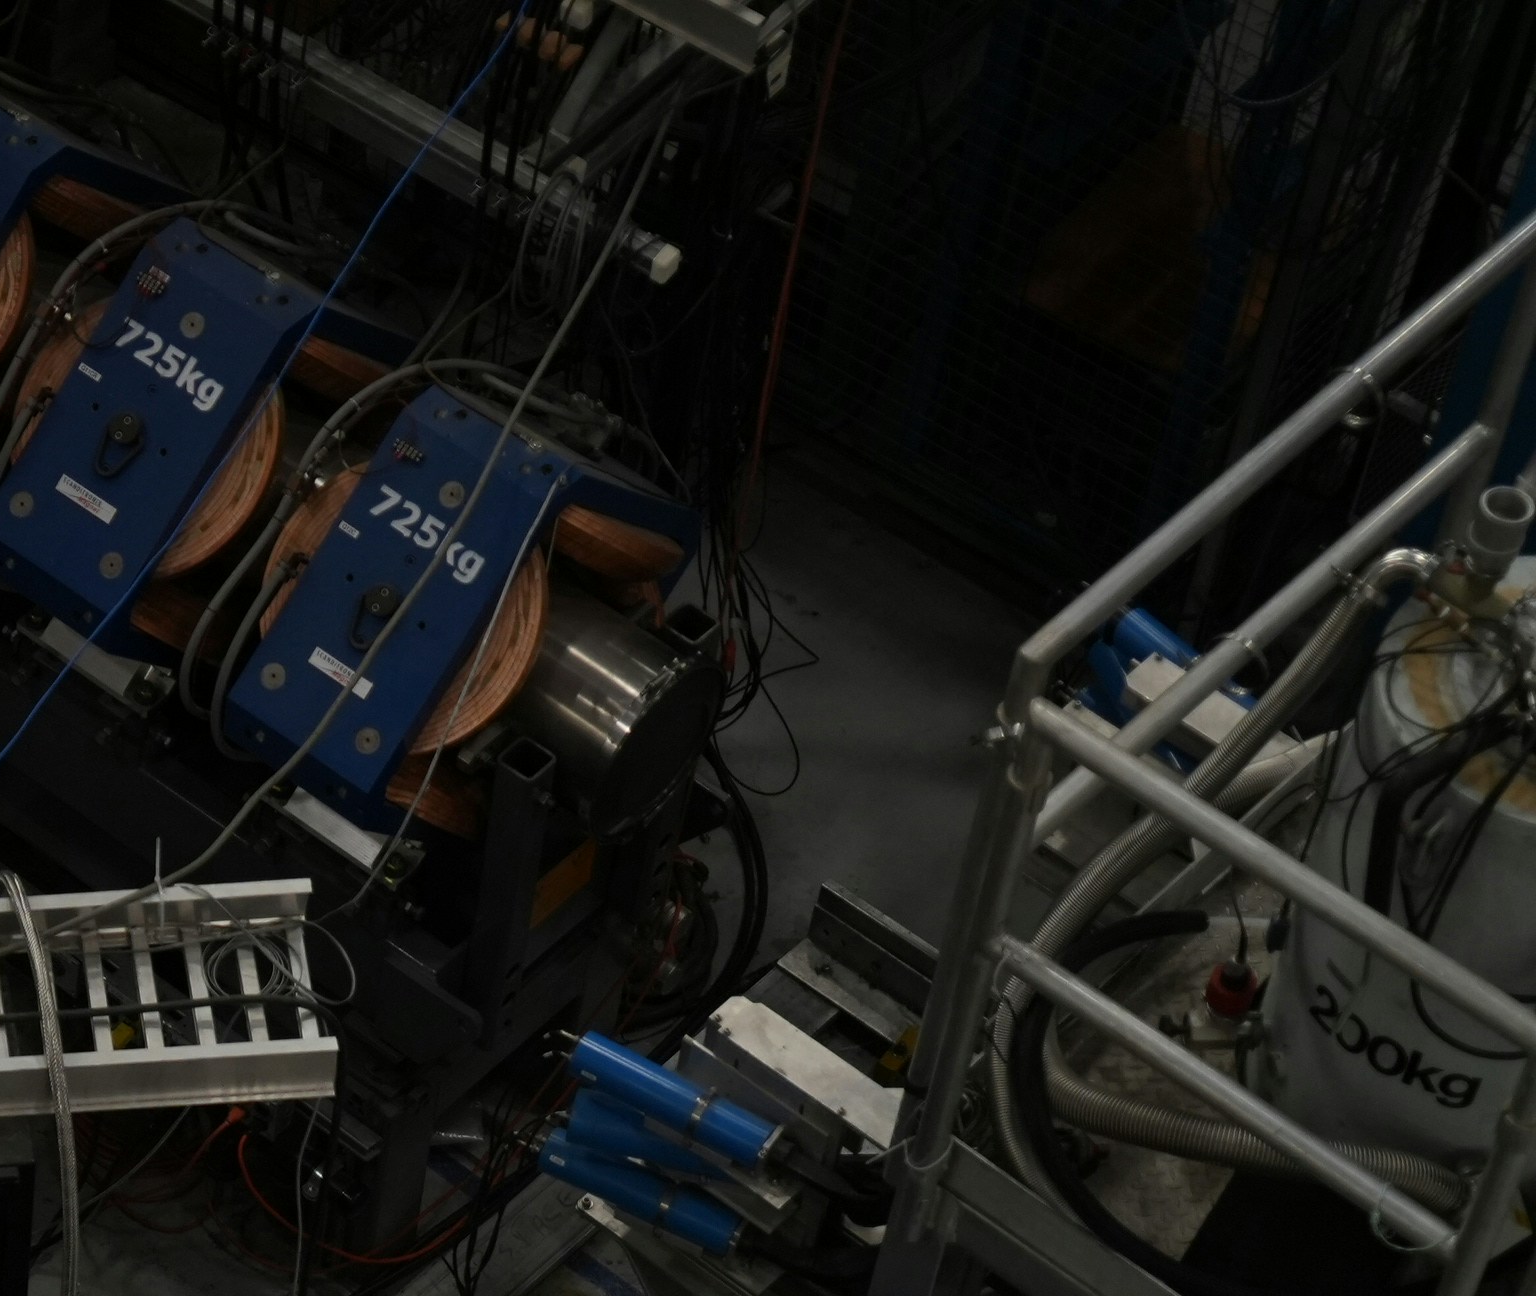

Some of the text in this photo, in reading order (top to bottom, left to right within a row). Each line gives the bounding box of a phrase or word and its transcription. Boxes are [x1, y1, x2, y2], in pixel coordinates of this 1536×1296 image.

[114, 316, 225, 412] 725kg
[368, 483, 487, 585] 725kg
[316, 650, 356, 678] SCANDITRON
[1309, 984, 1483, 1108] 200kg
